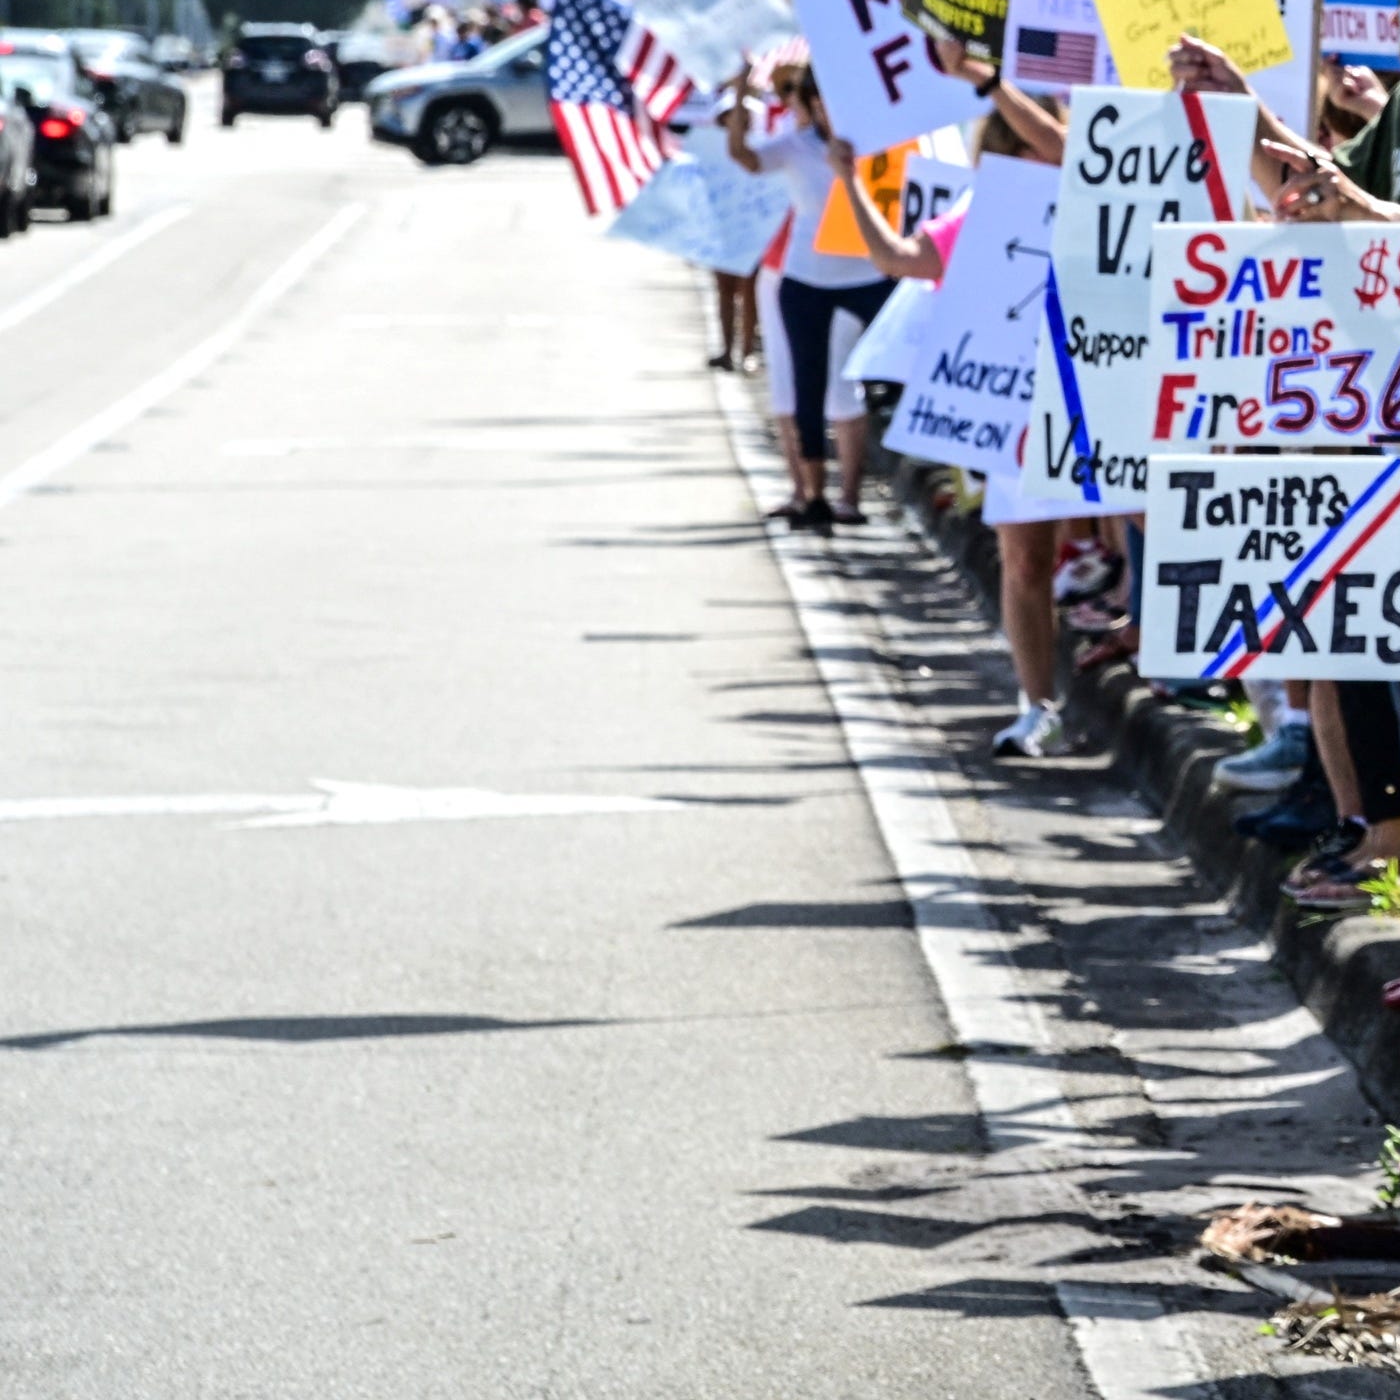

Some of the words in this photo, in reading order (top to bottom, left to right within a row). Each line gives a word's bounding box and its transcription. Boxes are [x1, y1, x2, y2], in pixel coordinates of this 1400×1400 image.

[1079, 104, 1212, 187] Save
[1066, 315, 1149, 367] Suppor
[1162, 308, 1335, 361] Trillions
[1045, 412, 1148, 494] Vetera
[1169, 470, 1350, 530] Tariffs
[1237, 529, 1305, 562] Are
